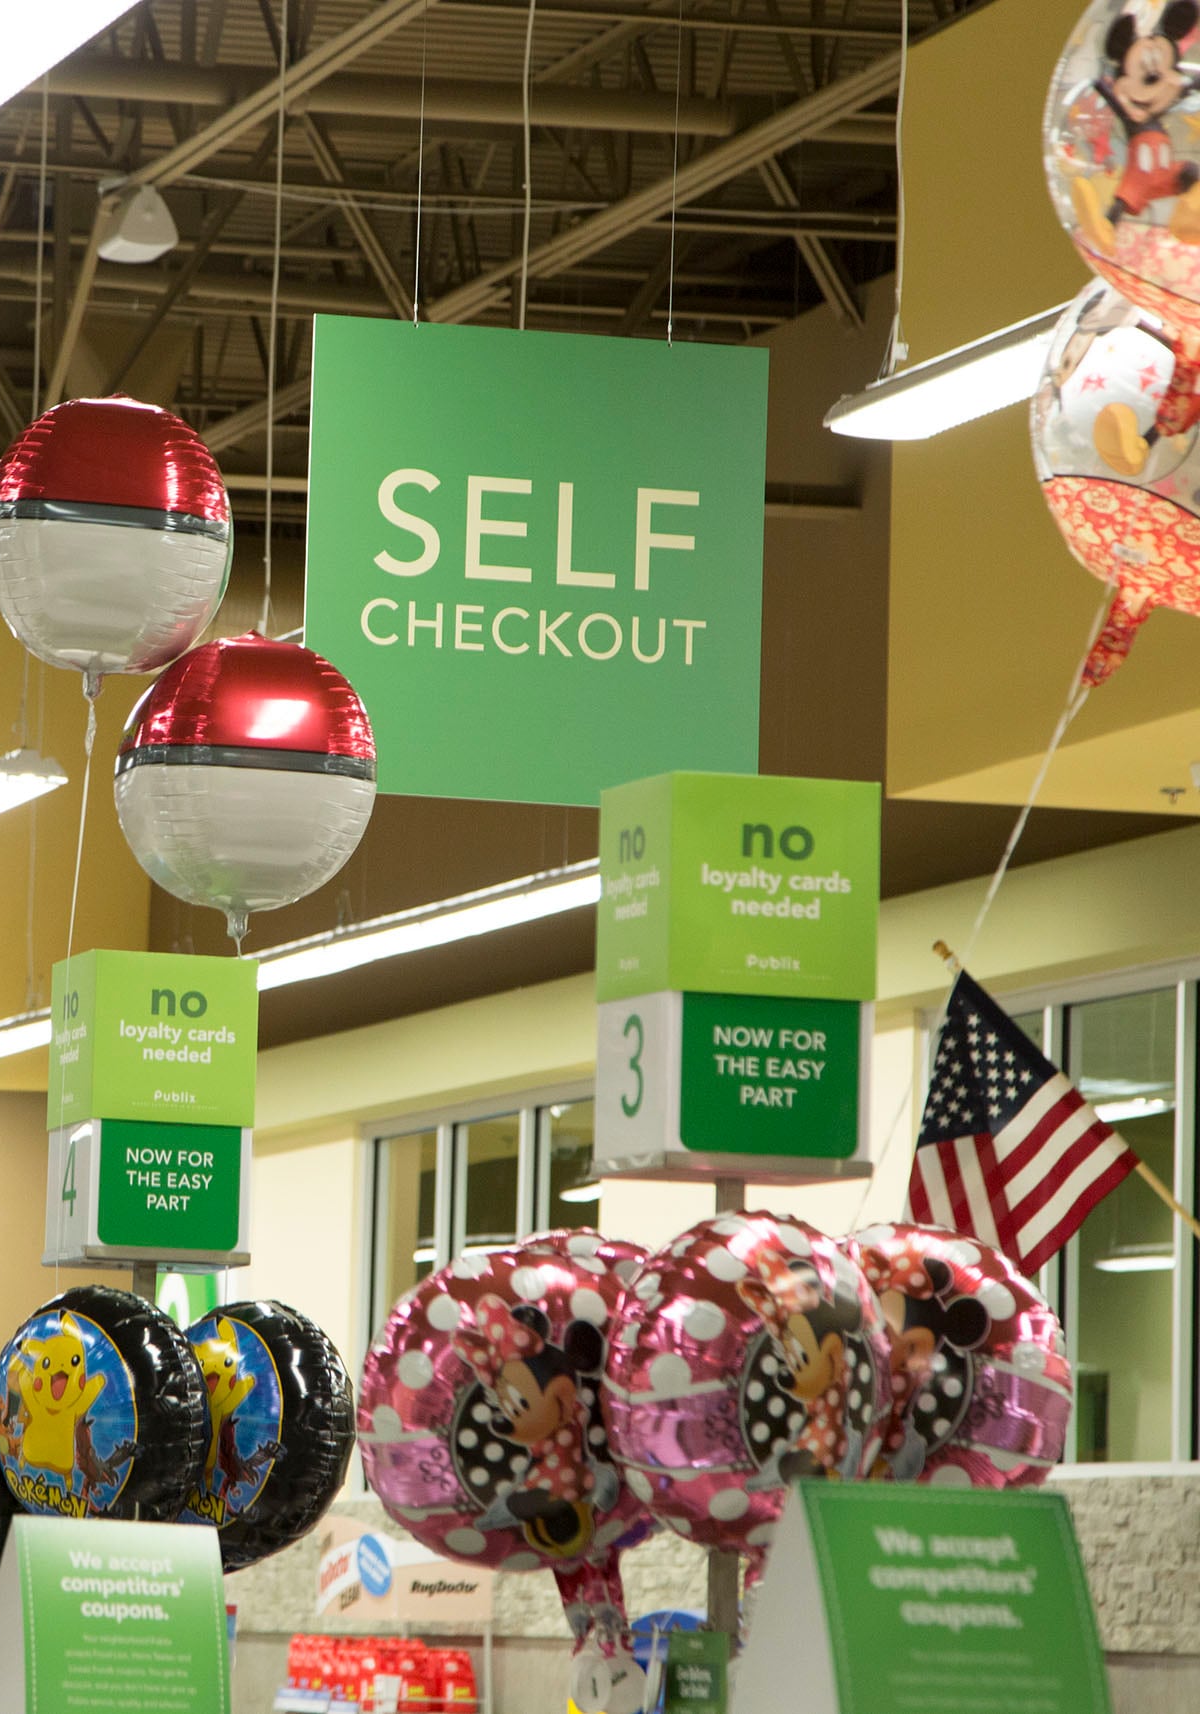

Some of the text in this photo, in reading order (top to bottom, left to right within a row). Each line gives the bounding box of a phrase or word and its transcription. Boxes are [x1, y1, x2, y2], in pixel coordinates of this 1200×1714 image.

[373, 468, 699, 591] SELF
[360, 598, 707, 665] CHECKOUT
[619, 826, 646, 863] no
[741, 822, 815, 860] no
[701, 863, 851, 895] loyalty cards
[731, 896, 821, 921] needed
[150, 987, 208, 1018] no
[119, 1020, 236, 1044] loyalty cards
[713, 1025, 827, 1052] NOW FOR
[142, 1045, 212, 1064] needed
[620, 1013, 645, 1119] 3
[713, 1054, 826, 1080] THE EASY
[153, 1089, 196, 1104] Publix
[740, 1085, 798, 1109] PART
[125, 1148, 214, 1168] NOW FOR
[61, 1140, 77, 1217] 4
[126, 1170, 213, 1191] THE EASY
[146, 1194, 191, 1212] PART
[873, 1525, 1020, 1566] We accept
[68, 1550, 173, 1576] We accept
[60, 1576, 184, 1598] competitors'
[411, 1579, 478, 1597] RugDoctor
[81, 1600, 169, 1623] coupons.
